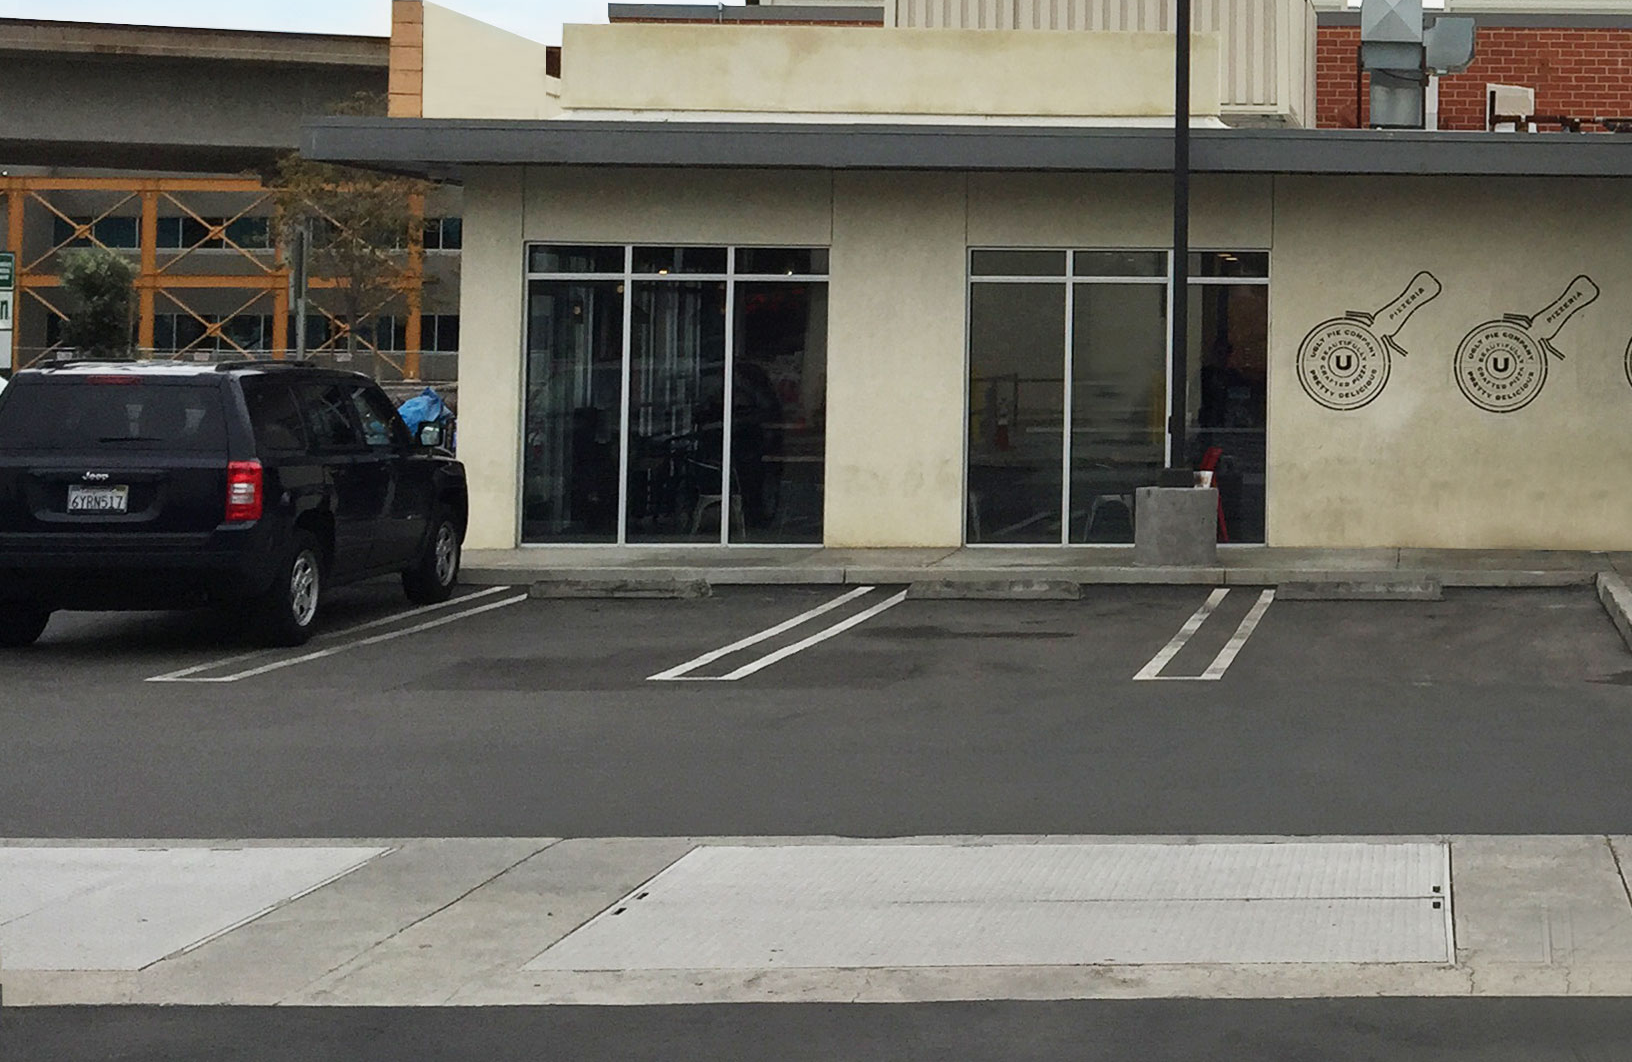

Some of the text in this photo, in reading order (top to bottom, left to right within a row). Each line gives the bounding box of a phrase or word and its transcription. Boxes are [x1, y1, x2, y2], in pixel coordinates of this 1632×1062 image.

[1389, 287, 1425, 320] PIZZERIA
[1546, 291, 1583, 324] PIZZERIA
[1310, 329, 1376, 358] UGLY PIE COMPANY
[1320, 340, 1367, 361] BEAUTIFULLY
[1468, 332, 1534, 361] UGLY PIE COMPANY
[1478, 342, 1524, 364] BEAUTIFULLY
[1335, 354, 1352, 370] U
[1493, 357, 1510, 373] U
[1309, 368, 1377, 398] PRETTY DELICIOUS
[1320, 364, 1367, 387] CRAFTED PIZZA
[1467, 371, 1534, 400] PRETTY DELICIOUS
[1477, 366, 1524, 389] CRAFTED PIZZA
